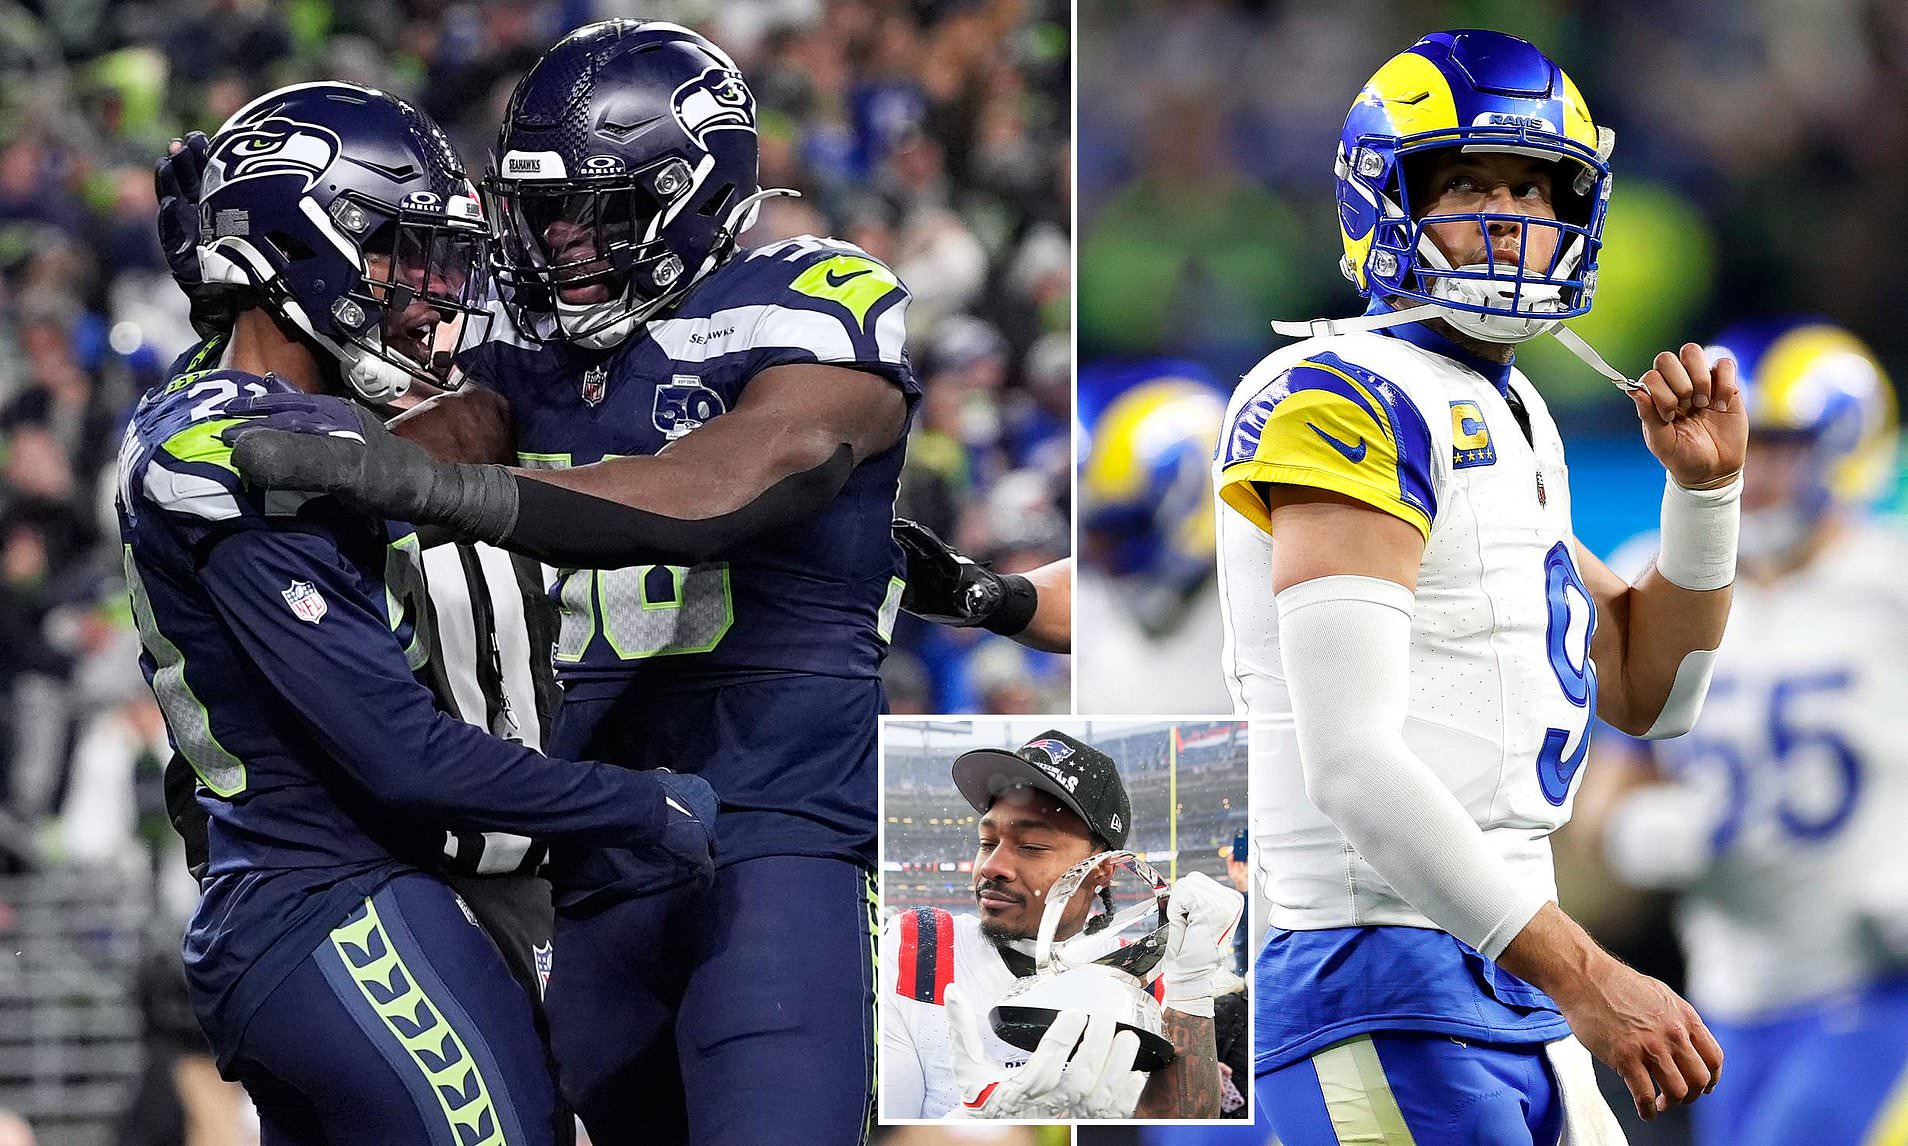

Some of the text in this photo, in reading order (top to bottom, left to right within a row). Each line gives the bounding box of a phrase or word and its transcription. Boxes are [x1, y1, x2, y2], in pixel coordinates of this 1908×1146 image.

[1489, 114, 1543, 129] RAMS
[509, 159, 541, 171] SEAHAWKS
[581, 167, 625, 175] OAKLEY
[403, 202, 442, 212] OAKLEY
[1450, 404, 1490, 451] C
[294, 595, 323, 617] NFL
[1536, 540, 1598, 807] 9
